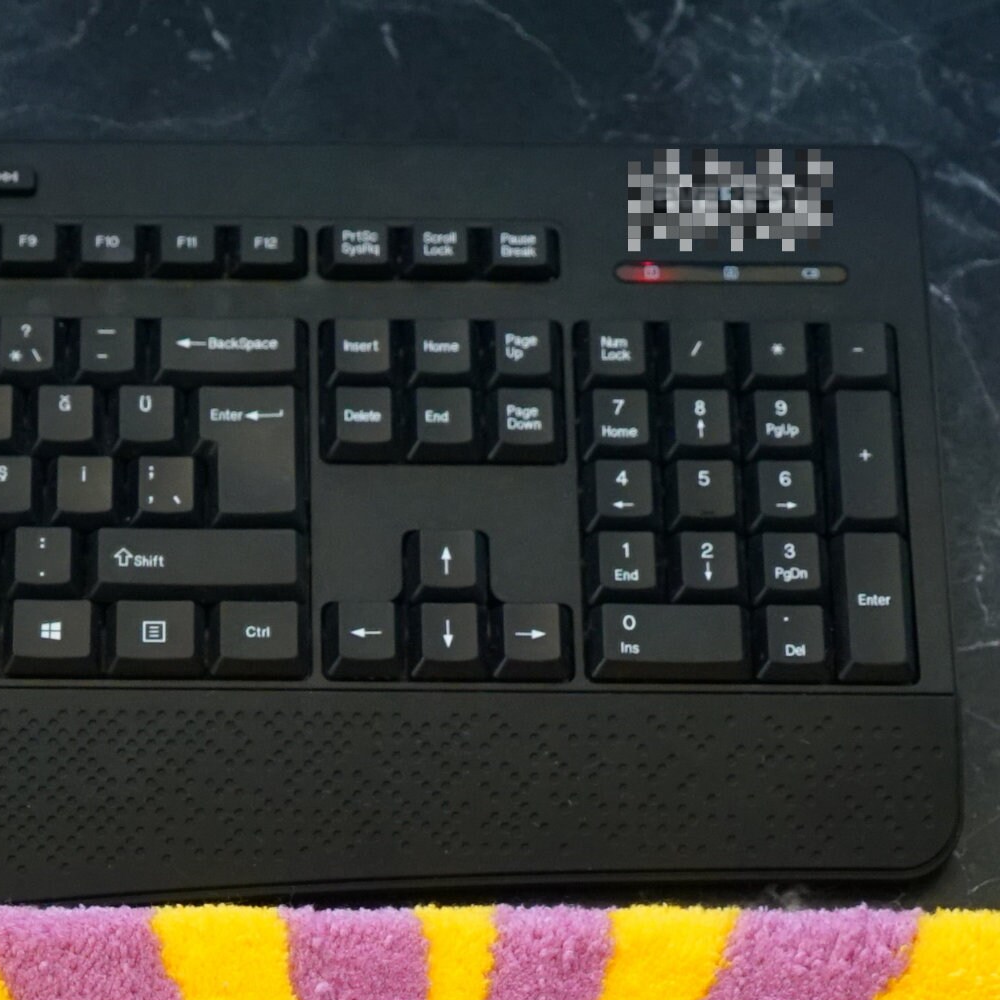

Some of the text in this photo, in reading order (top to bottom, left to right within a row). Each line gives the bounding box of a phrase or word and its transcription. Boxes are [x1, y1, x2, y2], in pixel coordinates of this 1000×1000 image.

[18, 233, 39, 248] F9
[95, 234, 121, 249] F10
[176, 235, 198, 249] F11
[253, 235, 279, 250] F12
[422, 231, 458, 244] Scroll
[500, 232, 537, 245] Pause
[423, 244, 454, 256] Lock
[500, 245, 538, 257] Break
[20, 323, 32, 338] ?
[206, 336, 279, 352] BackSpace
[342, 339, 380, 353] Insert
[422, 339, 461, 353] Home
[504, 333, 539, 349] Page
[600, 336, 628, 349] Num
[505, 348, 524, 361] Up
[600, 348, 632, 361] Lock
[209, 408, 244, 421] Enter
[506, 404, 539, 419] Page
[612, 398, 626, 416] 7
[693, 399, 707, 417] 8
[774, 399, 789, 417] 9
[343, 408, 382, 423] Delete
[424, 409, 450, 424] End
[506, 418, 543, 431] Down
[601, 424, 639, 439] Home
[765, 422, 801, 439] PgUp
[615, 469, 629, 487] 4
[697, 469, 711, 487] 5
[778, 470, 793, 488] 6
[621, 541, 630, 559] 1
[700, 541, 715, 559] 2
[783, 542, 797, 560] 3
[133, 554, 165, 567] Shift
[613, 568, 640, 582] End
[774, 566, 809, 583] PgDn
[856, 592, 892, 607] Enter
[621, 614, 637, 631] 0
[244, 625, 271, 639] Ctrl
[620, 641, 641, 655] Ins
[784, 643, 807, 657] Del
